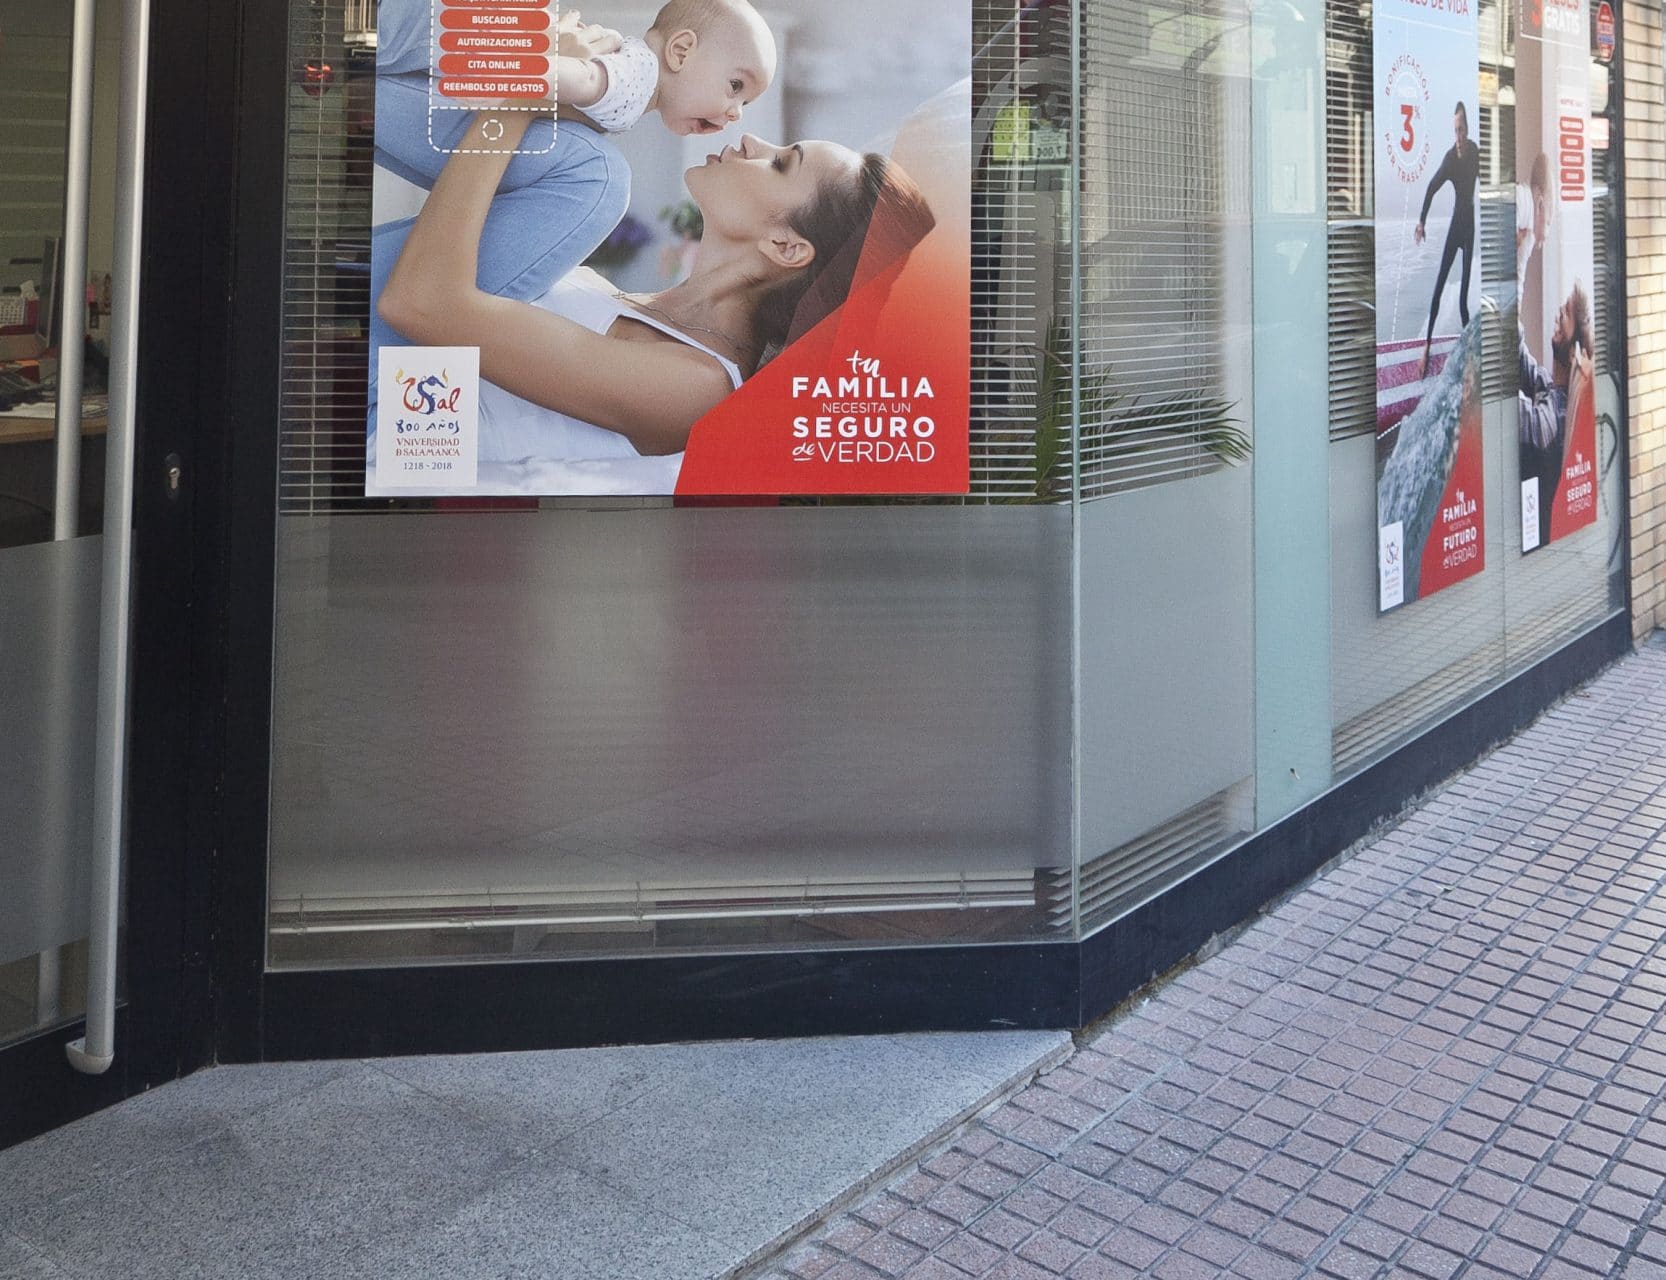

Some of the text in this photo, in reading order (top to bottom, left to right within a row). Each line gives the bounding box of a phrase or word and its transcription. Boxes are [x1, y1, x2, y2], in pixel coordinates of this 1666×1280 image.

[471, 15, 519, 25] BUSCADOR
[1543, 5, 1580, 35] GRATIS
[457, 37, 533, 48] AUTORIZACIONES
[467, 60, 521, 70] CITA ONLINE
[443, 82, 544, 93] REEMBOLSO DE GASTOS
[846, 349, 880, 378] tu
[792, 376, 935, 399] FAMILIA
[822, 402, 911, 414] NECESITA UN
[396, 420, 420, 434] 800
[792, 416, 935, 438] SEGURO
[792, 441, 935, 462] de VERDAD
[404, 462, 424, 470] 1218
[431, 462, 452, 470] 2018
[1566, 460, 1591, 480] FAMILIA
[1567, 481, 1592, 502] SEGURO
[1443, 499, 1477, 523] FAMILIA
[1443, 526, 1477, 552] FUTURO
